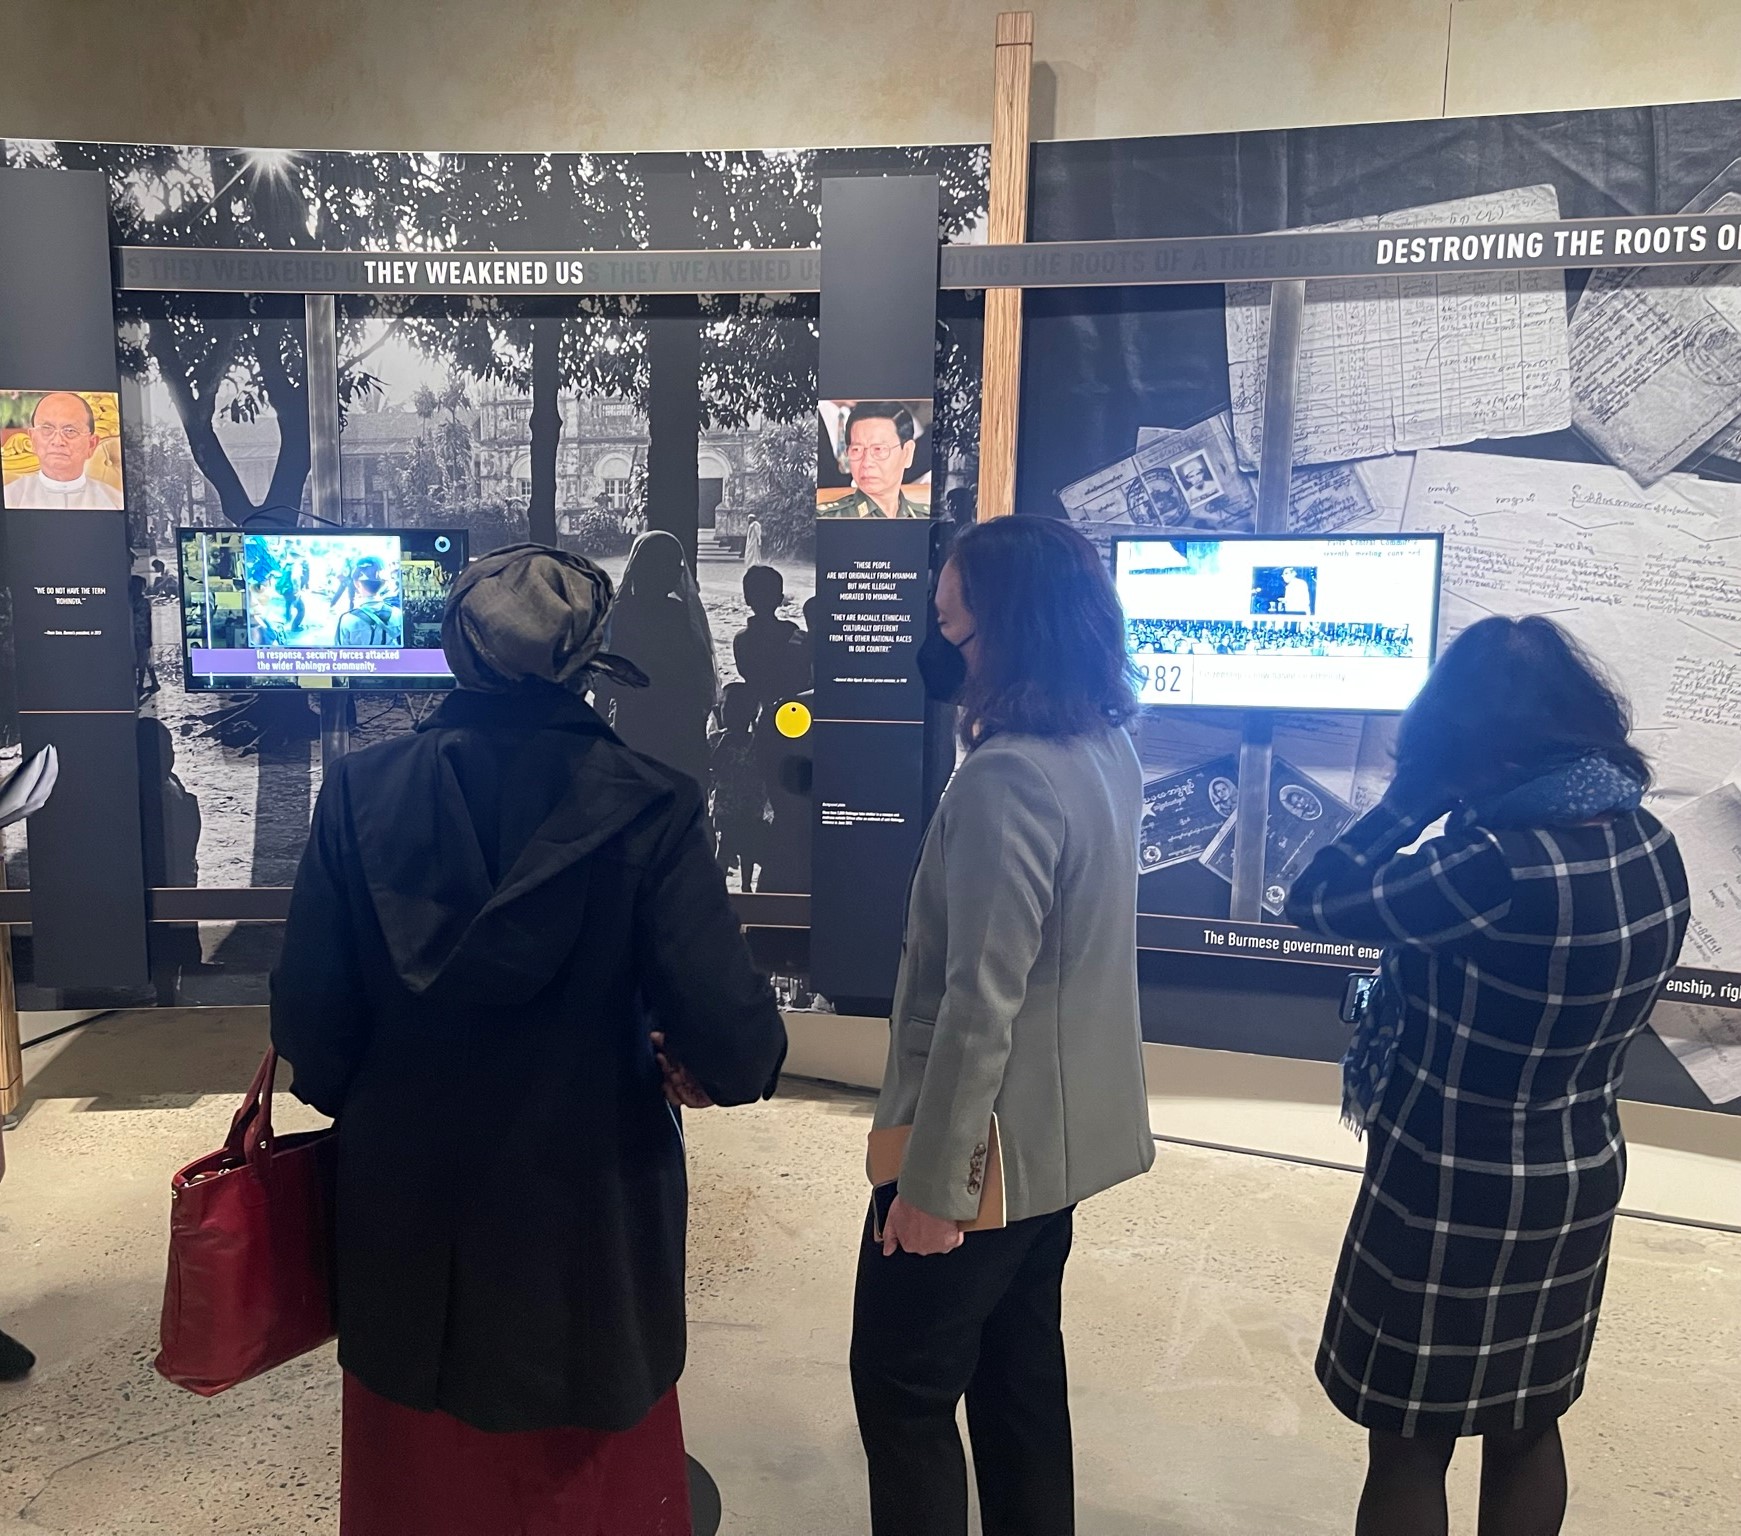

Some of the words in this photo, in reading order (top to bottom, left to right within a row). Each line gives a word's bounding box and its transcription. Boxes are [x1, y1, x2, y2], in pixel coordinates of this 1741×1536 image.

[1376, 232, 1543, 264] DESTROYING
[1554, 230, 1604, 257] THE
[1614, 226, 1706, 255] ROOTS
[150, 257, 202, 280] THEY
[212, 257, 337, 281] WEAKENED
[364, 261, 421, 284] THEY
[426, 261, 548, 284] WEAKENED
[556, 261, 584, 284] US
[608, 260, 661, 283] THEY
[670, 259, 791, 283] WEAKENED
[848, 572, 877, 580] ORIGINALLY
[877, 572, 891, 580] FROM
[892, 572, 917, 580] MYANMAR
[857, 614, 881, 622] RACIALLY,
[882, 614, 911, 622] ETHNICALLY,
[843, 624, 872, 632] CULTURALLY
[896, 635, 912, 643] RACES
[256, 650, 265, 660] In
[266, 651, 304, 662] response,
[306, 650, 337, 661] security
[339, 650, 364, 660] forces
[365, 650, 399, 660] attacked
[257, 661, 271, 670] the
[272, 661, 294, 670] wider
[295, 661, 331, 673] Rohingya
[332, 662, 377, 673] community.
[1203, 930, 1225, 945] The
[1228, 932, 1280, 950] Burmese
[1283, 939, 1354, 957] government
[1720, 983, 1741, 1002] rig
